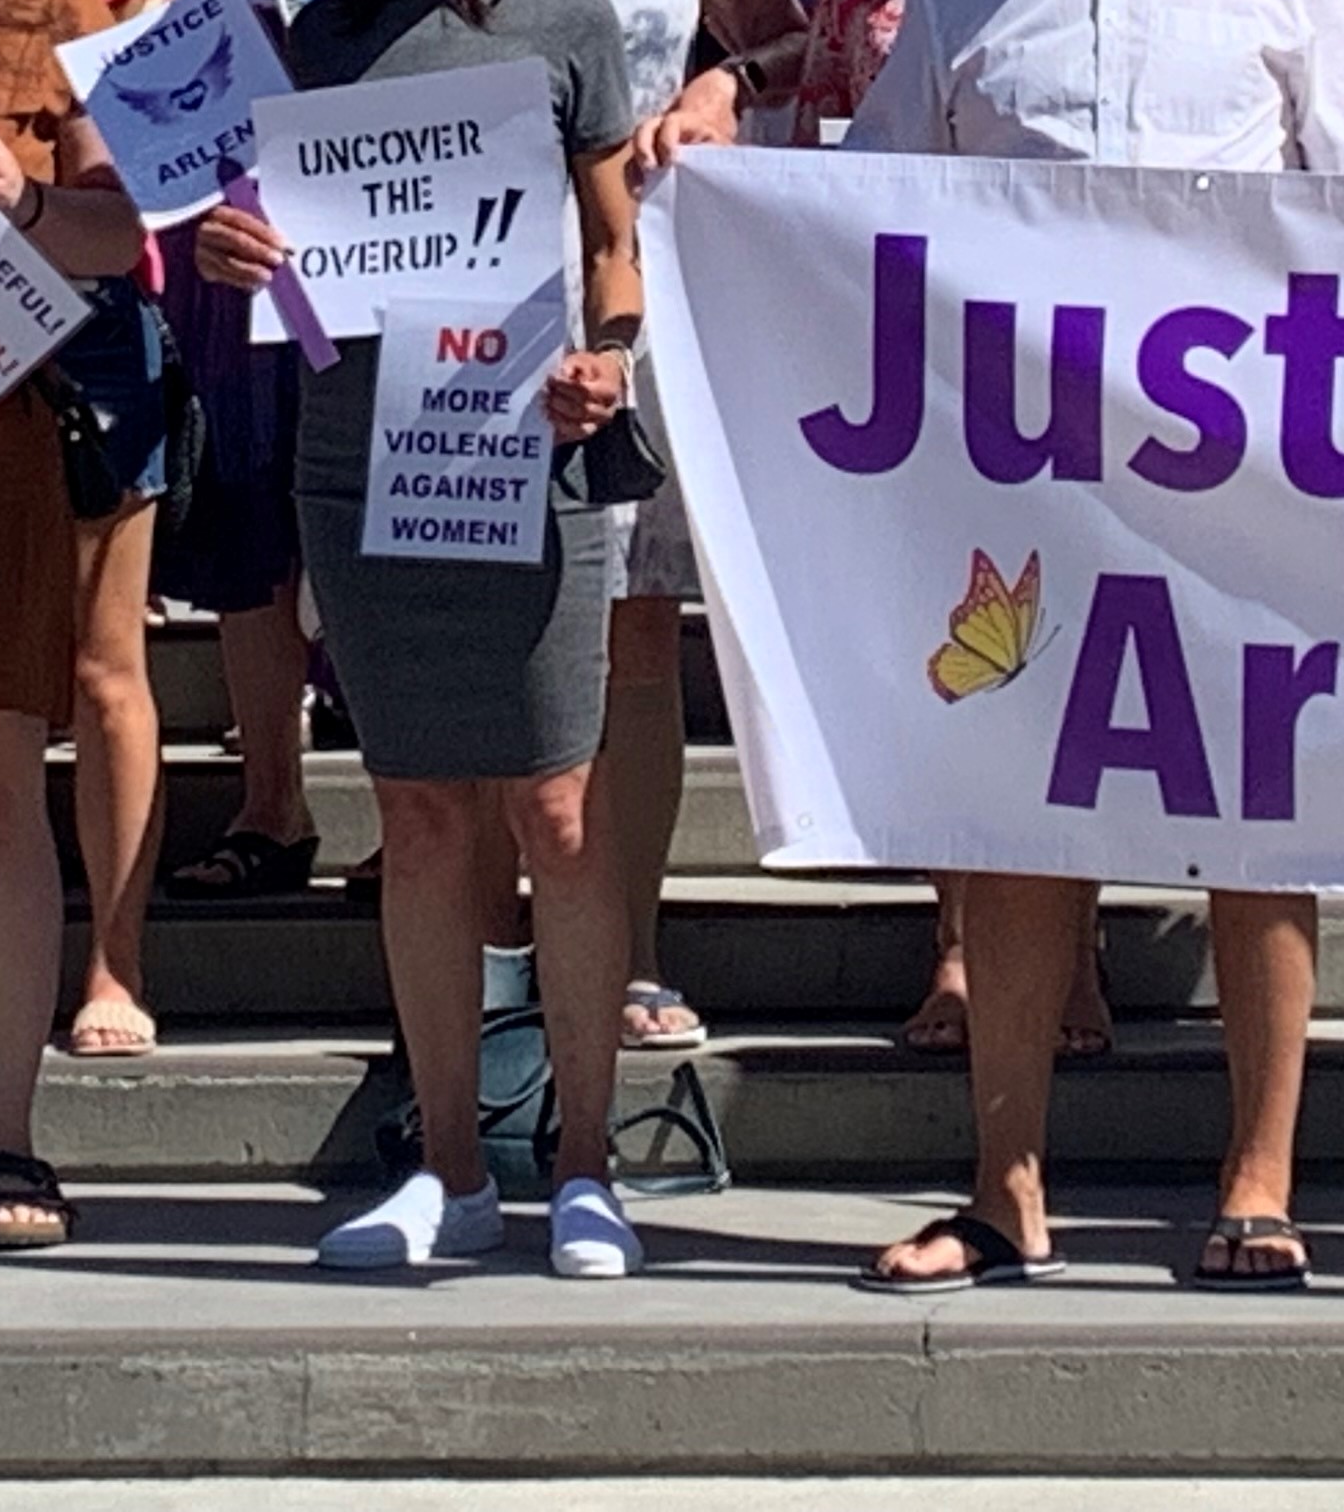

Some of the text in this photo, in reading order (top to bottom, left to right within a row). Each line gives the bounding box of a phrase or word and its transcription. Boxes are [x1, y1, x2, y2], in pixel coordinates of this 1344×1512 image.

[158, 118, 255, 186] ARLEN
[298, 119, 484, 177] UNCOVER
[361, 175, 434, 218] THE
[284, 232, 458, 279] OVERUP
[436, 327, 508, 365] NO
[422, 387, 511, 414] MORE
[384, 429, 541, 459] VIOLENCE
[389, 473, 528, 502] AGAINST
[392, 517, 518, 545] WOMEN!
